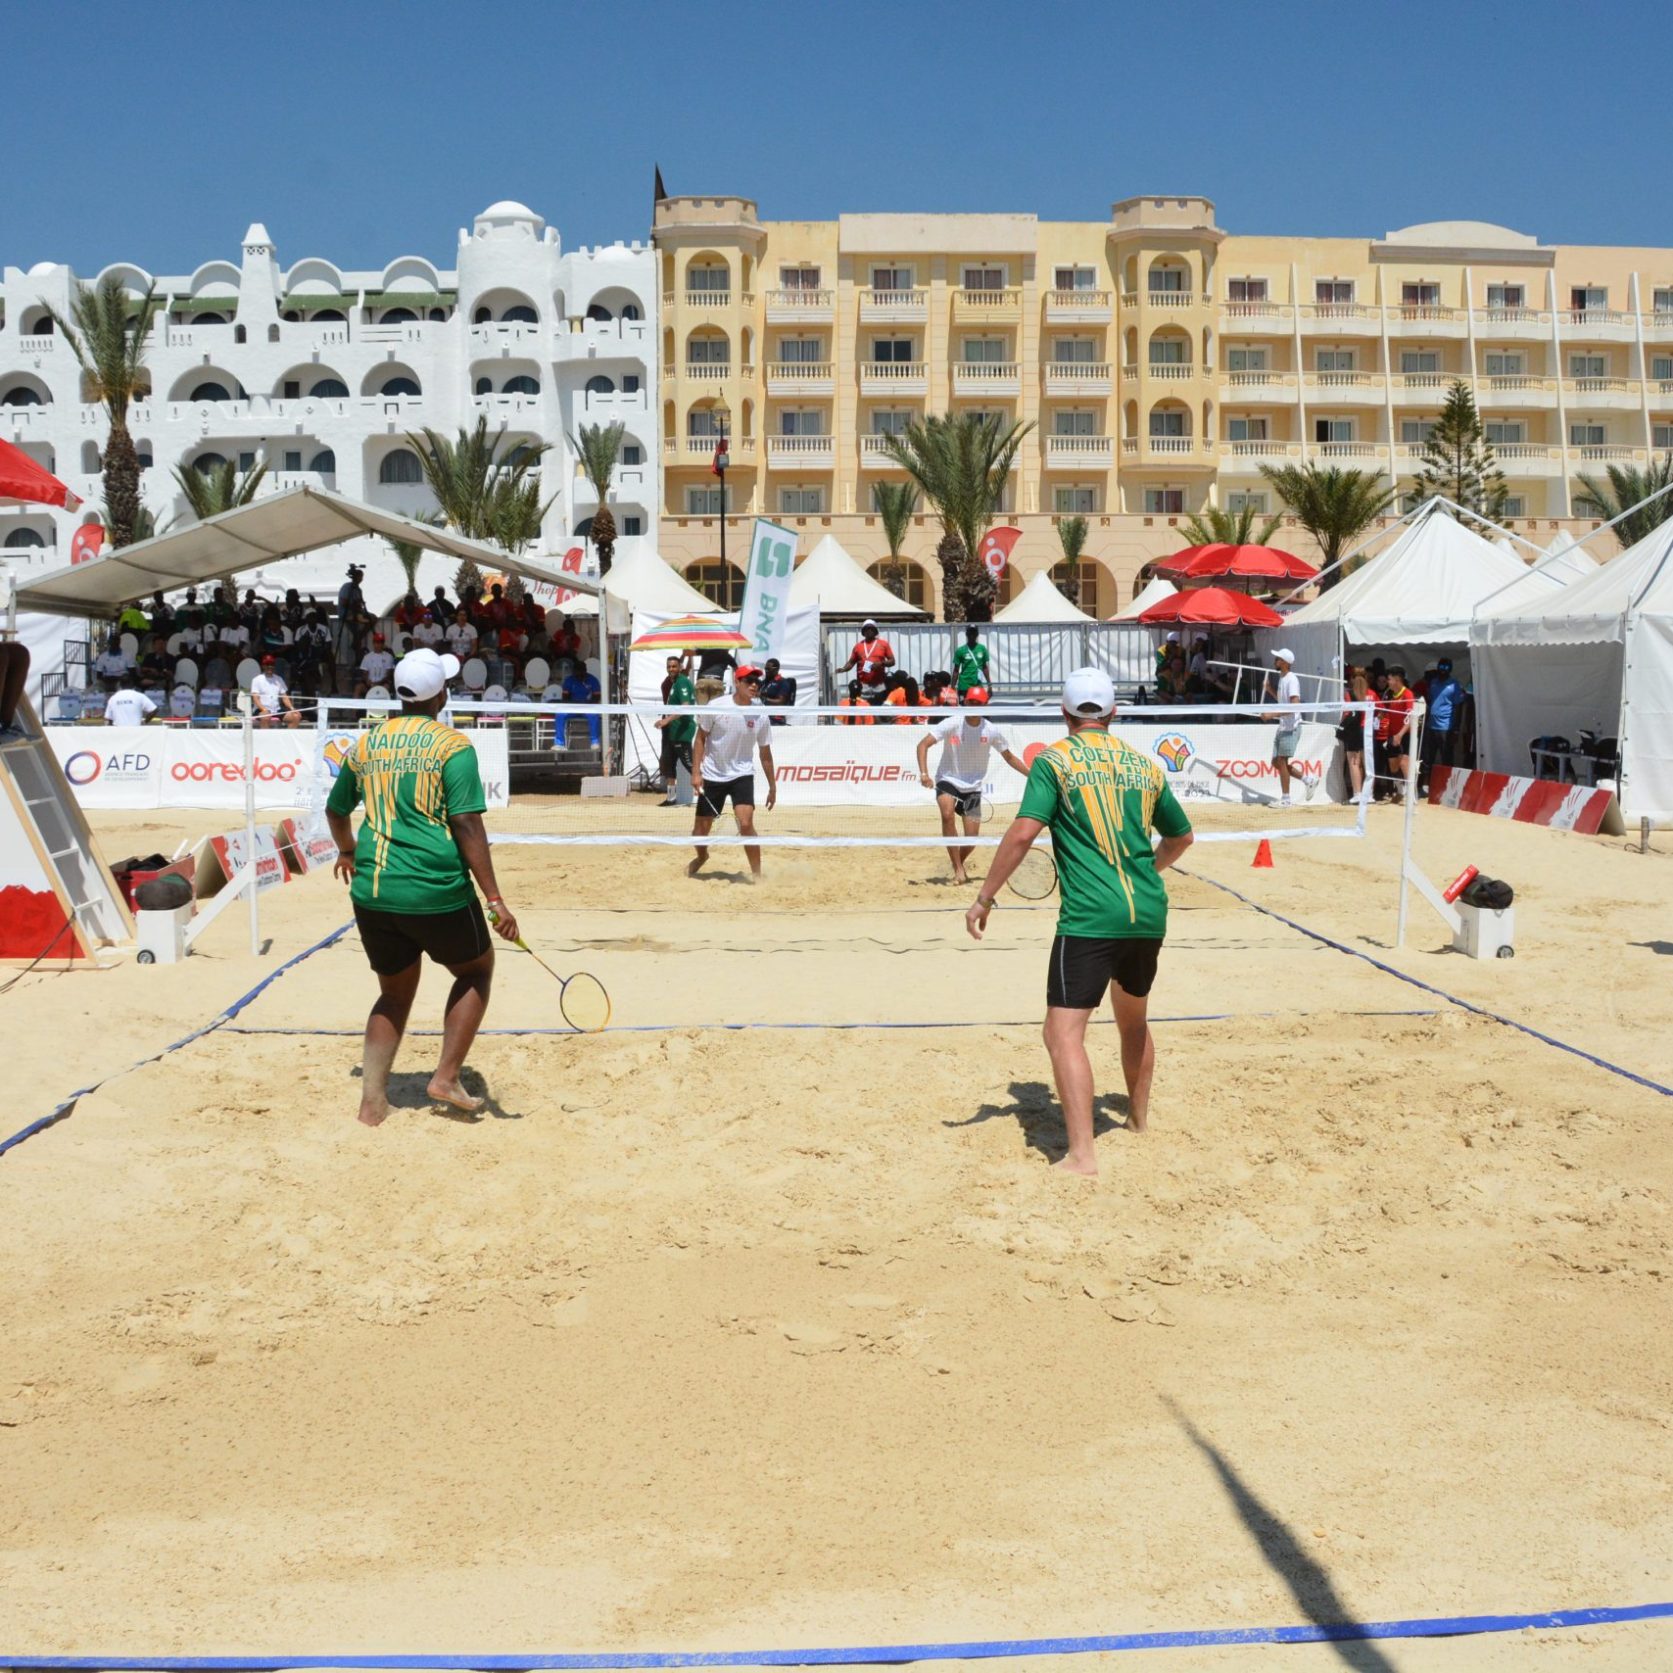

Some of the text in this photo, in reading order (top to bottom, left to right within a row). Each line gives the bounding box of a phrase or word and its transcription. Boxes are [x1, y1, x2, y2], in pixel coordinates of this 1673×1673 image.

[752, 592, 779, 652] BNA
[366, 733, 434, 751] NAIDOO
[105, 753, 151, 771] AFD
[395, 757, 442, 773] AFRICA
[1215, 760, 1322, 778] ZOOMOM
[776, 760, 901, 785] mosaïque
[1067, 769, 1113, 788] SOUTH
